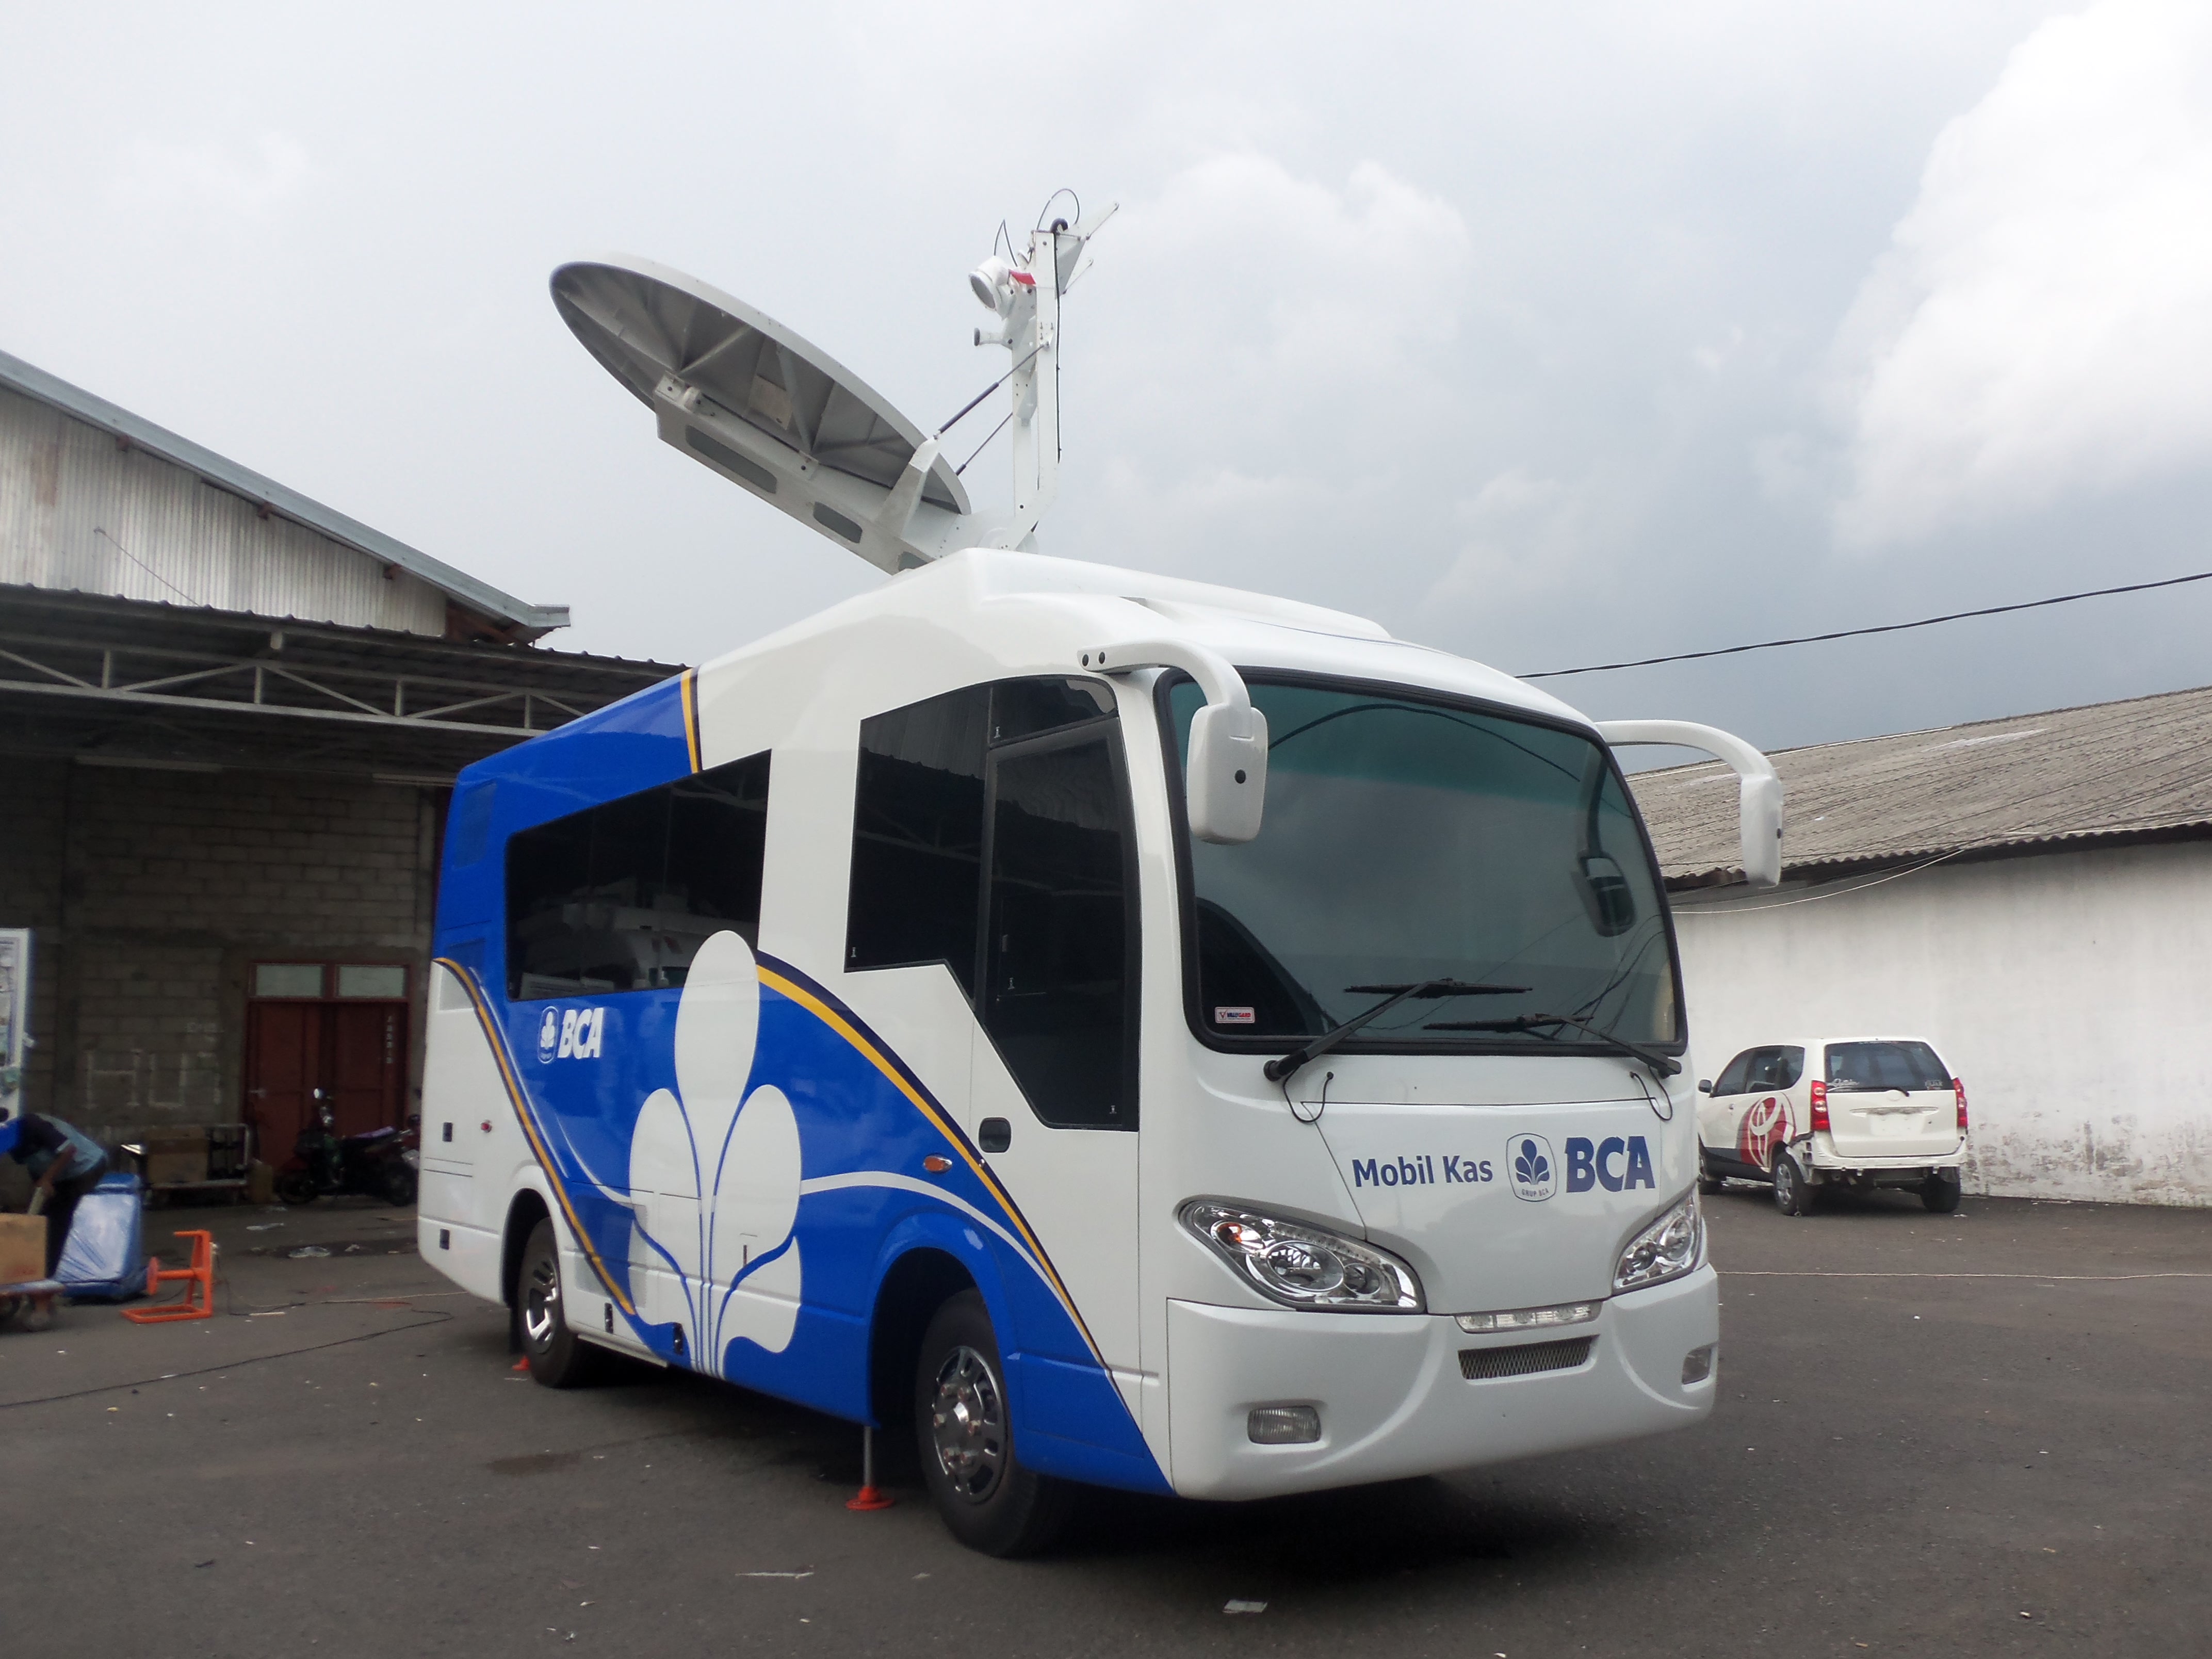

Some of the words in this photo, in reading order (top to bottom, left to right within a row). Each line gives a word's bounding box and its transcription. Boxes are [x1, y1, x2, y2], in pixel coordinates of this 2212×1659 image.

[557, 1007, 604, 1059] BCA
[1352, 1155, 1434, 1187] Mobil
[1442, 1155, 1493, 1183] Kas
[1564, 1135, 1655, 1192] BCA
[1521, 1189, 1537, 1197] GRUP
[1538, 1188, 1549, 1197] BCA
